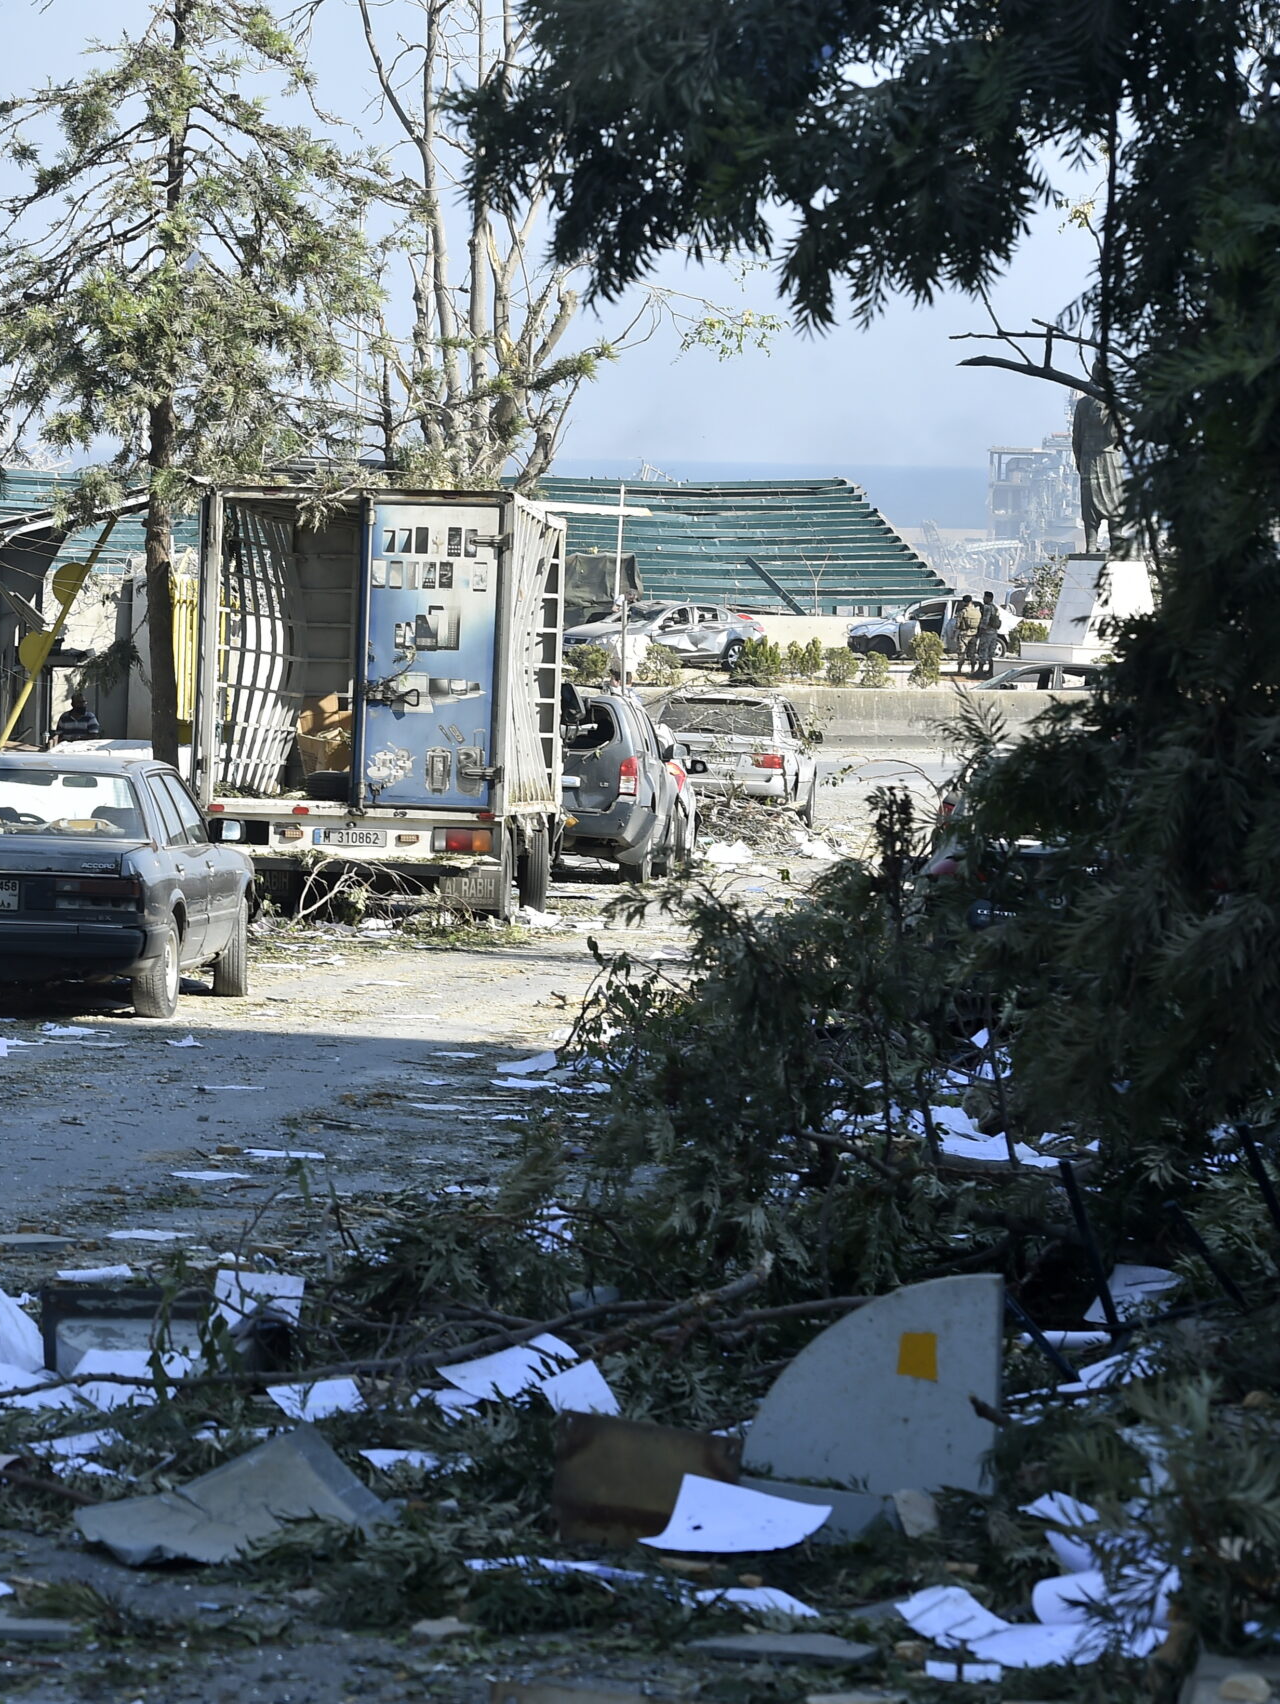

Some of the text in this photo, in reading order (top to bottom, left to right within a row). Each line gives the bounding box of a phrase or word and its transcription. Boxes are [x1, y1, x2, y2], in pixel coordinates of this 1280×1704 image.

[323, 830, 380, 845] M 310862
[257, 870, 289, 891] ABIH
[461, 878, 495, 898] RABIH
